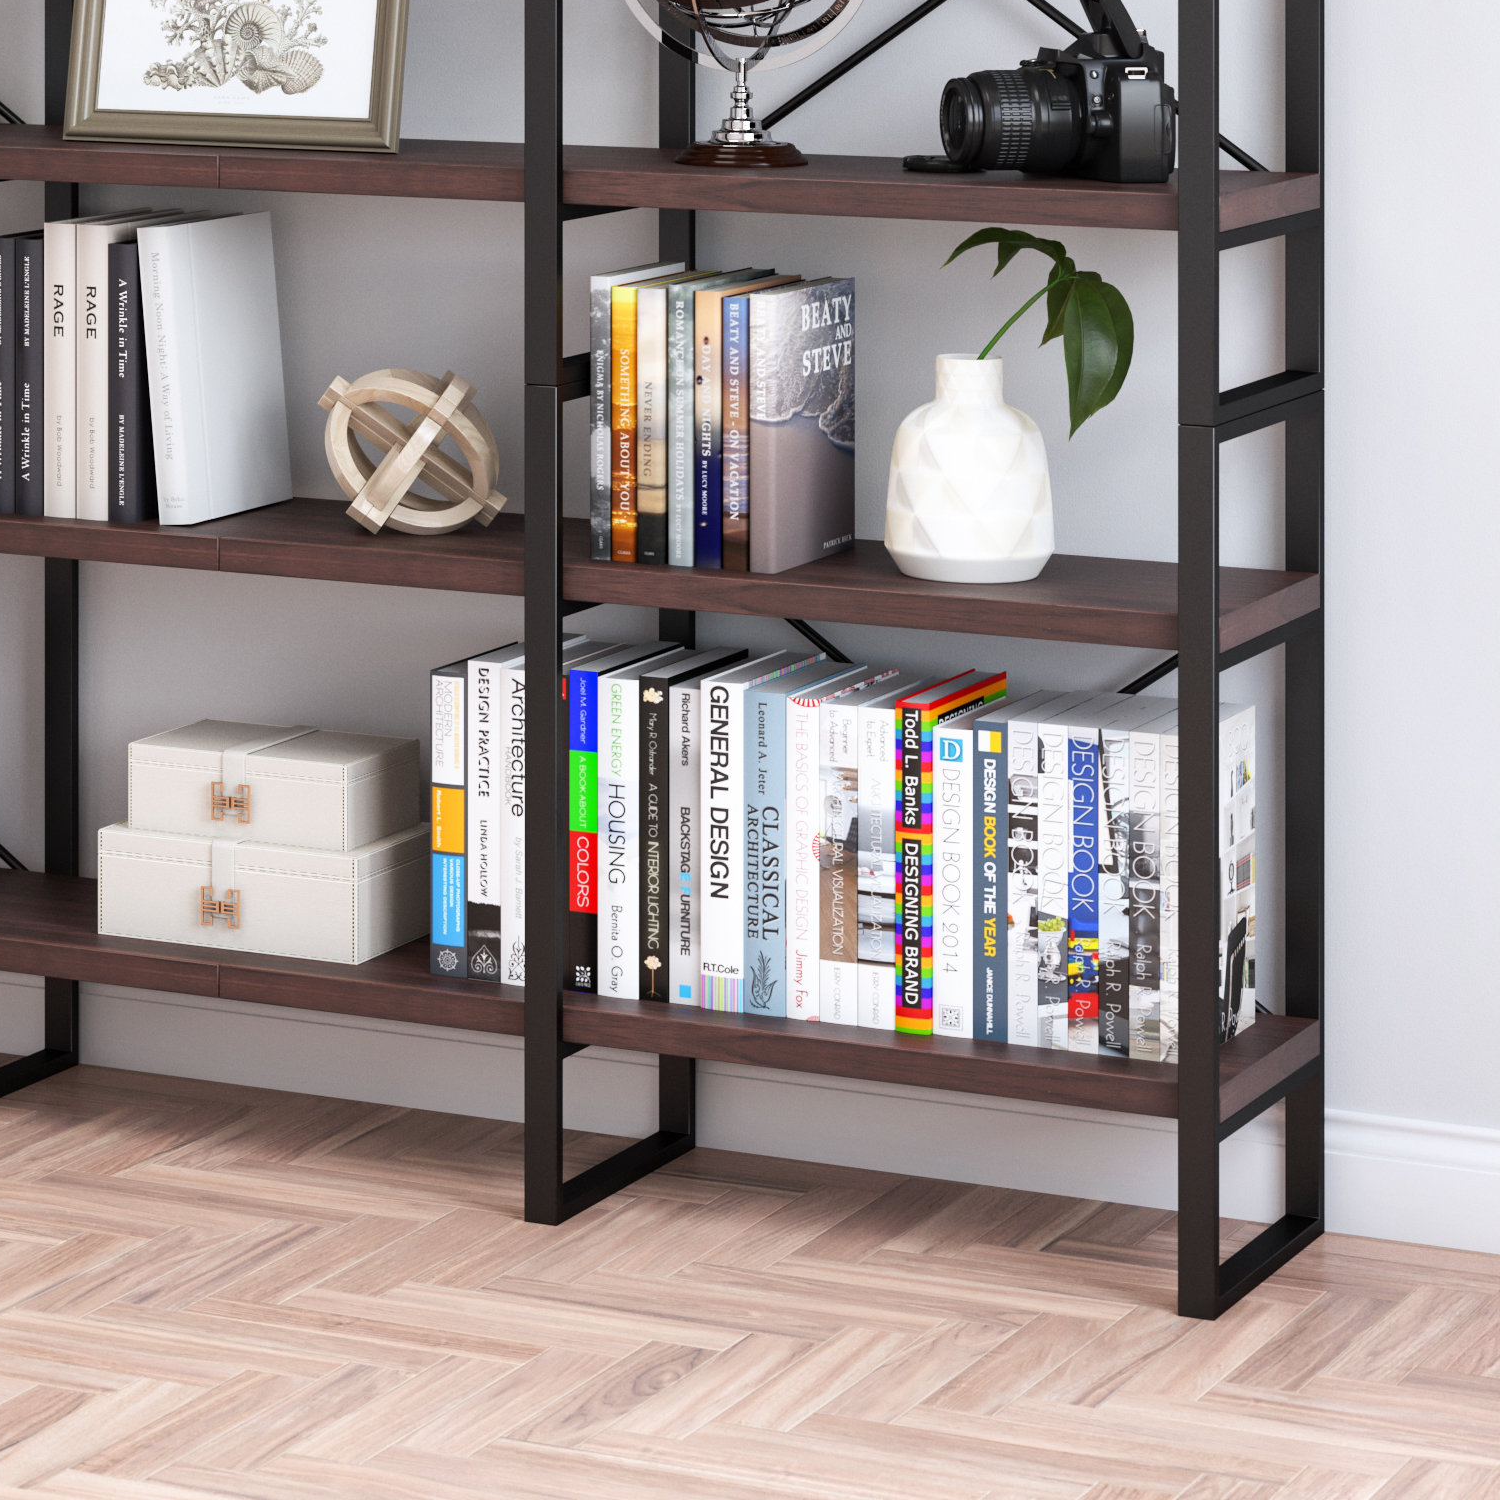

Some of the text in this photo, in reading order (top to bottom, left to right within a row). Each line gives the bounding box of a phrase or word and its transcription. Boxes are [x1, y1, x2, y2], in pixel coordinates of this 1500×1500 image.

[53, 284, 64, 338] RAGE
[86, 286, 97, 339] RAGE
[150, 252, 161, 298] Morning
[155, 303, 163, 329] Noon
[801, 294, 852, 332] BEATY
[118, 279, 127, 378] A Wrinkle in Time
[802, 342, 852, 377] STEVE
[836, 323, 852, 340] AND
[56, 415, 62, 428] by
[119, 415, 125, 423] BY
[160, 373, 169, 381] A
[160, 383, 173, 411] Way
[164, 414, 171, 427] of
[729, 304, 740, 521] BEATY AND STEVE ON VACATION
[164, 429, 173, 460] Living
[620, 348, 631, 511] SOMETHING ABOUT YOU
[643, 382, 652, 477] NEVER ENDING
[478, 668, 490, 797] DESIGN PRACTICE
[510, 678, 525, 817] Architecture
[610, 683, 622, 777] GREEN ENERGY
[681, 693, 690, 767] Richard Akers
[758, 702, 767, 795] Leonard A. Jeter
[904, 711, 919, 826] Todd L. Banks
[608, 784, 625, 884] HOUSING
[709, 685, 729, 899] GENERAL DESIGN
[1070, 735, 1095, 912] DESIGN BOOK
[480, 820, 488, 897] LINDA HOLLOW
[576, 836, 590, 908] COLORS
[647, 841, 659, 949] INTERIOR LIGHTING
[680, 806, 691, 956] BACKSTAGE FURNITURE
[747, 804, 758, 939] ARCHITECTURE
[762, 806, 781, 940] CLASSICAL
[940, 768, 961, 974] DESIGN BOOK 2014
[983, 759, 997, 957] DESIGN BOOK OF THE YEAR
[610, 905, 623, 993] Bernita O. Gray
[703, 963, 740, 975] R.T.Cole
[904, 842, 920, 1006] DESIGNING BRAND
[795, 949, 810, 1008] Jimmy Fox
